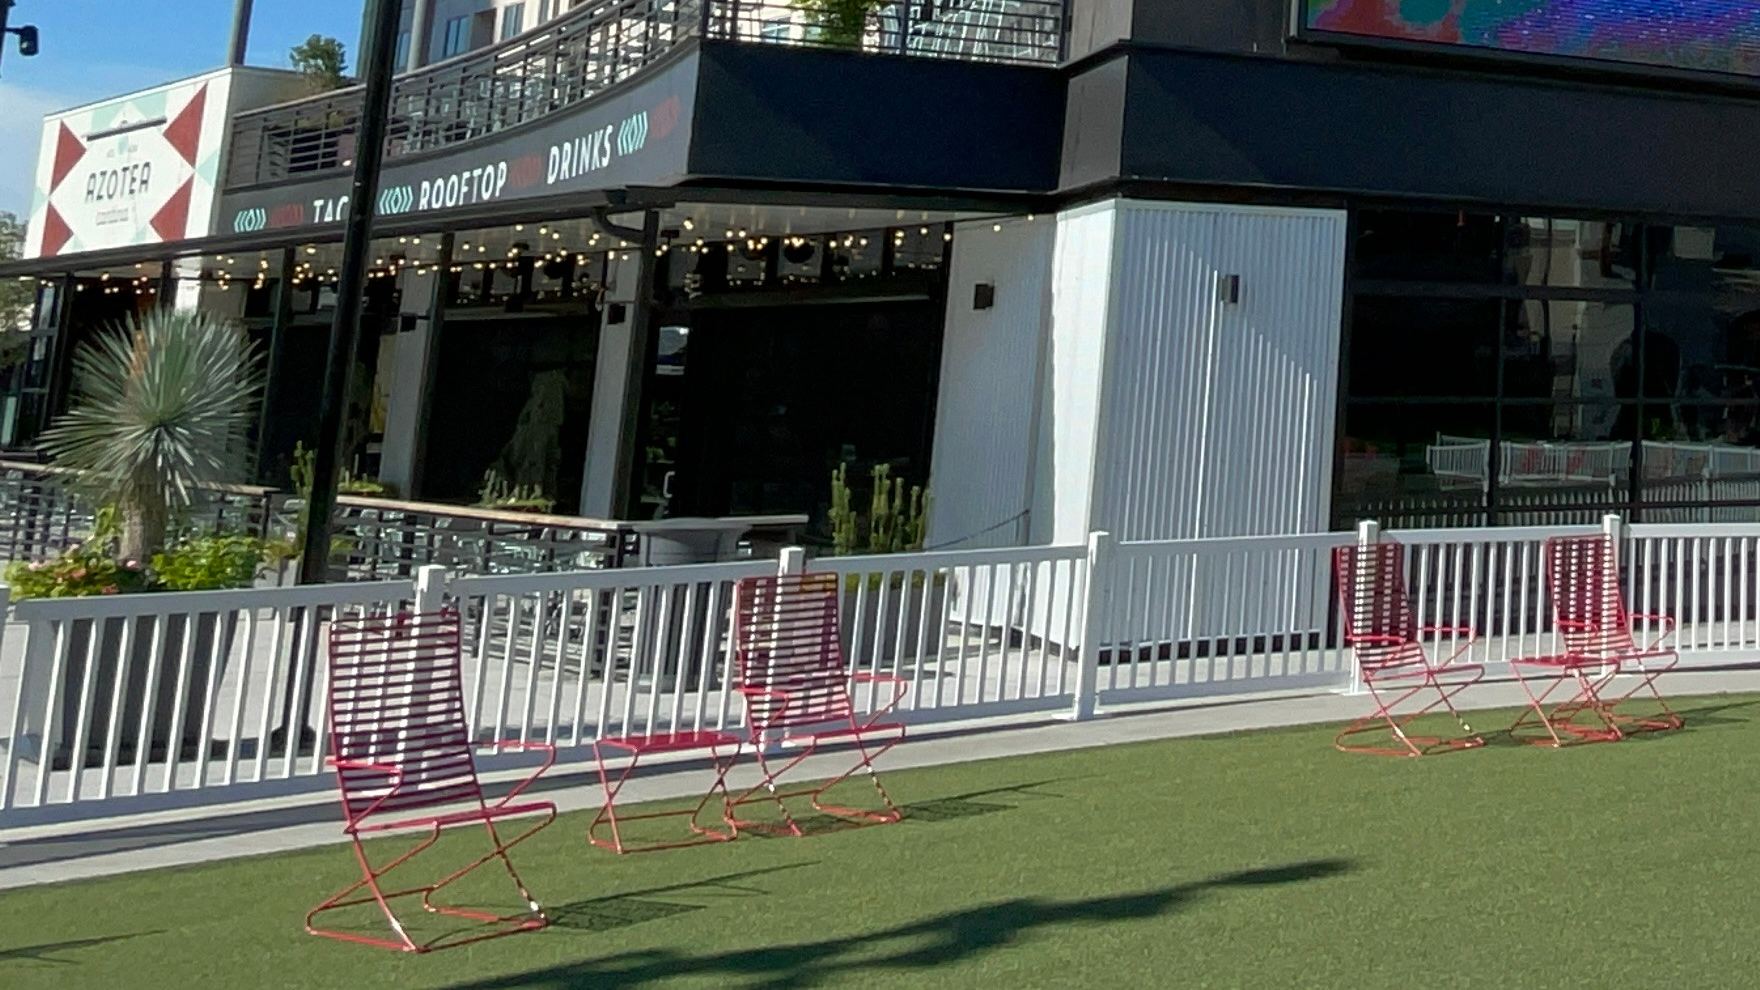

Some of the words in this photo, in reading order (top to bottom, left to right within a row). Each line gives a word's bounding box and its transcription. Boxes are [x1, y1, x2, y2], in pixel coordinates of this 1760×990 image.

[85, 161, 152, 203] AZOTEA
[313, 195, 351, 224] TAC
[418, 161, 508, 211] ROOFTOP
[546, 124, 614, 185] DRINKS
